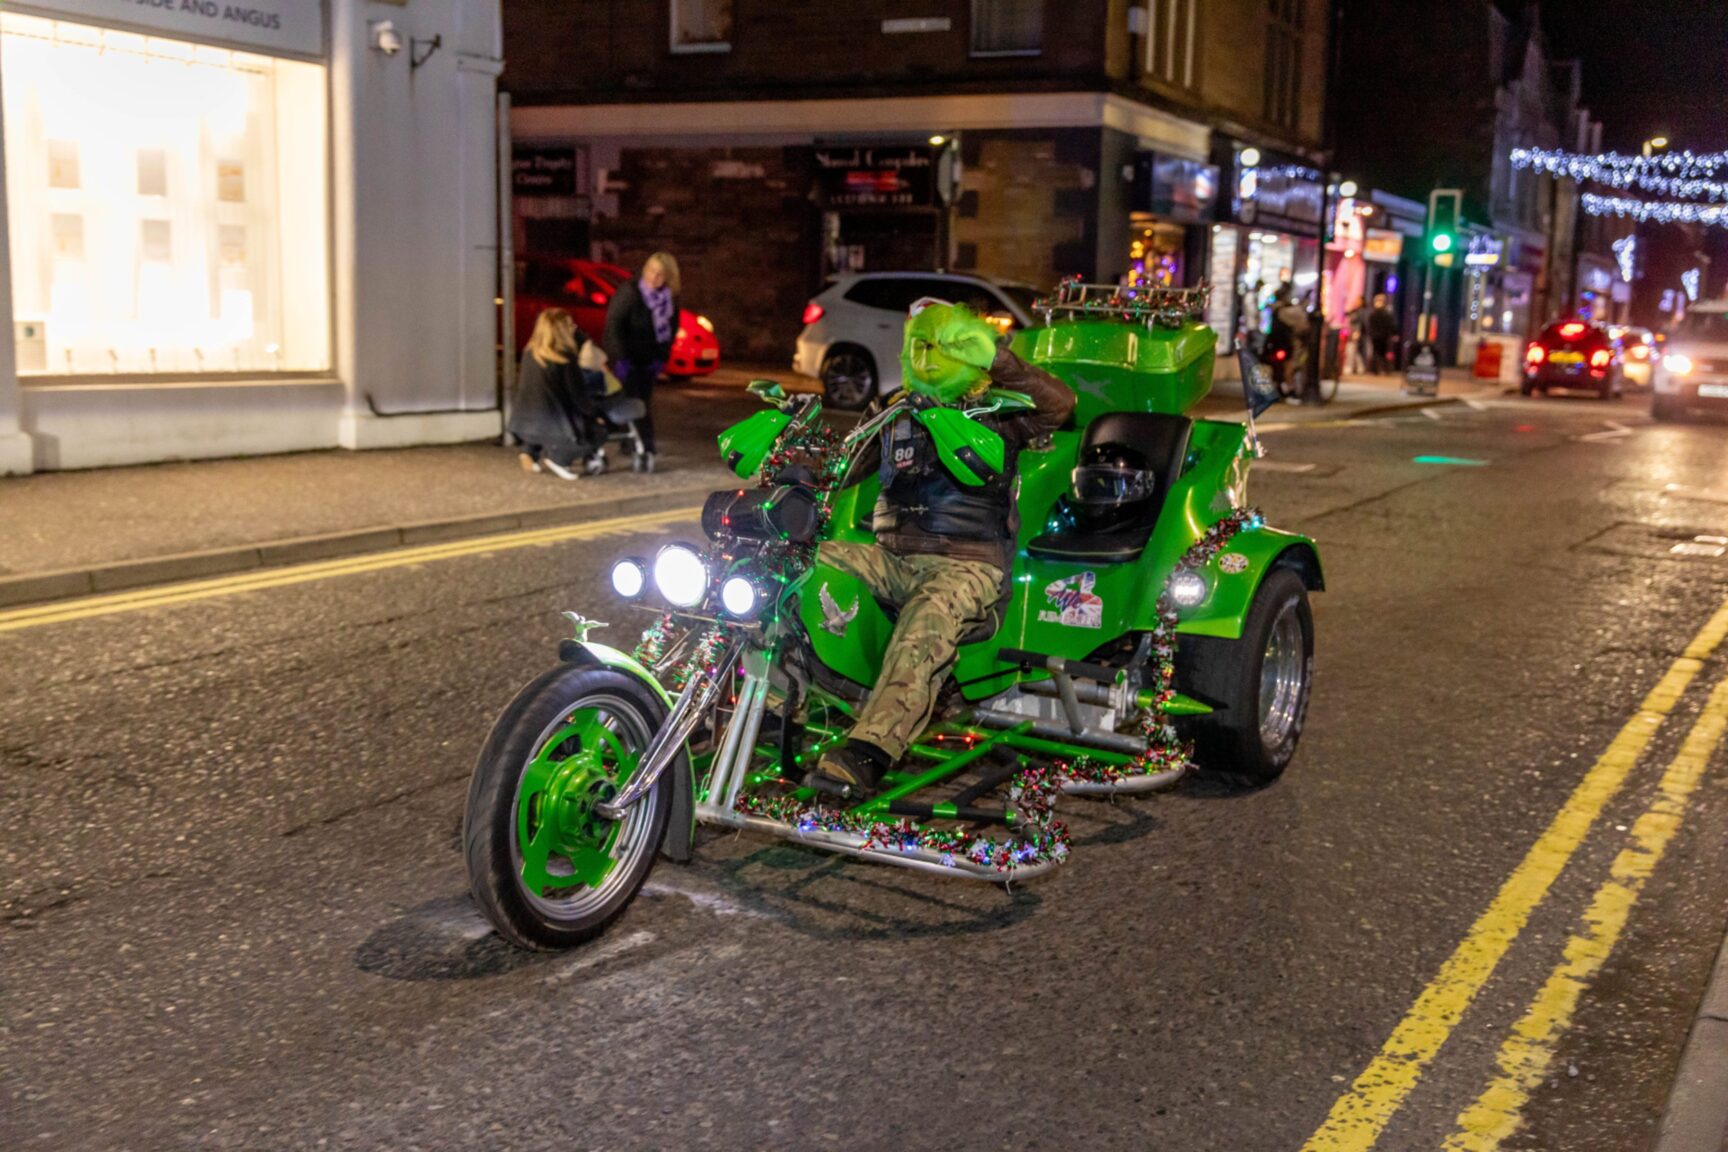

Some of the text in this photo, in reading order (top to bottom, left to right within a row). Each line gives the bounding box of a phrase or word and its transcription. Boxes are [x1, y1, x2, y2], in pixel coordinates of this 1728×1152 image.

[180, 0, 219, 18] AND
[223, 5, 281, 30] ANGUS
[895, 446, 915, 462] 80
